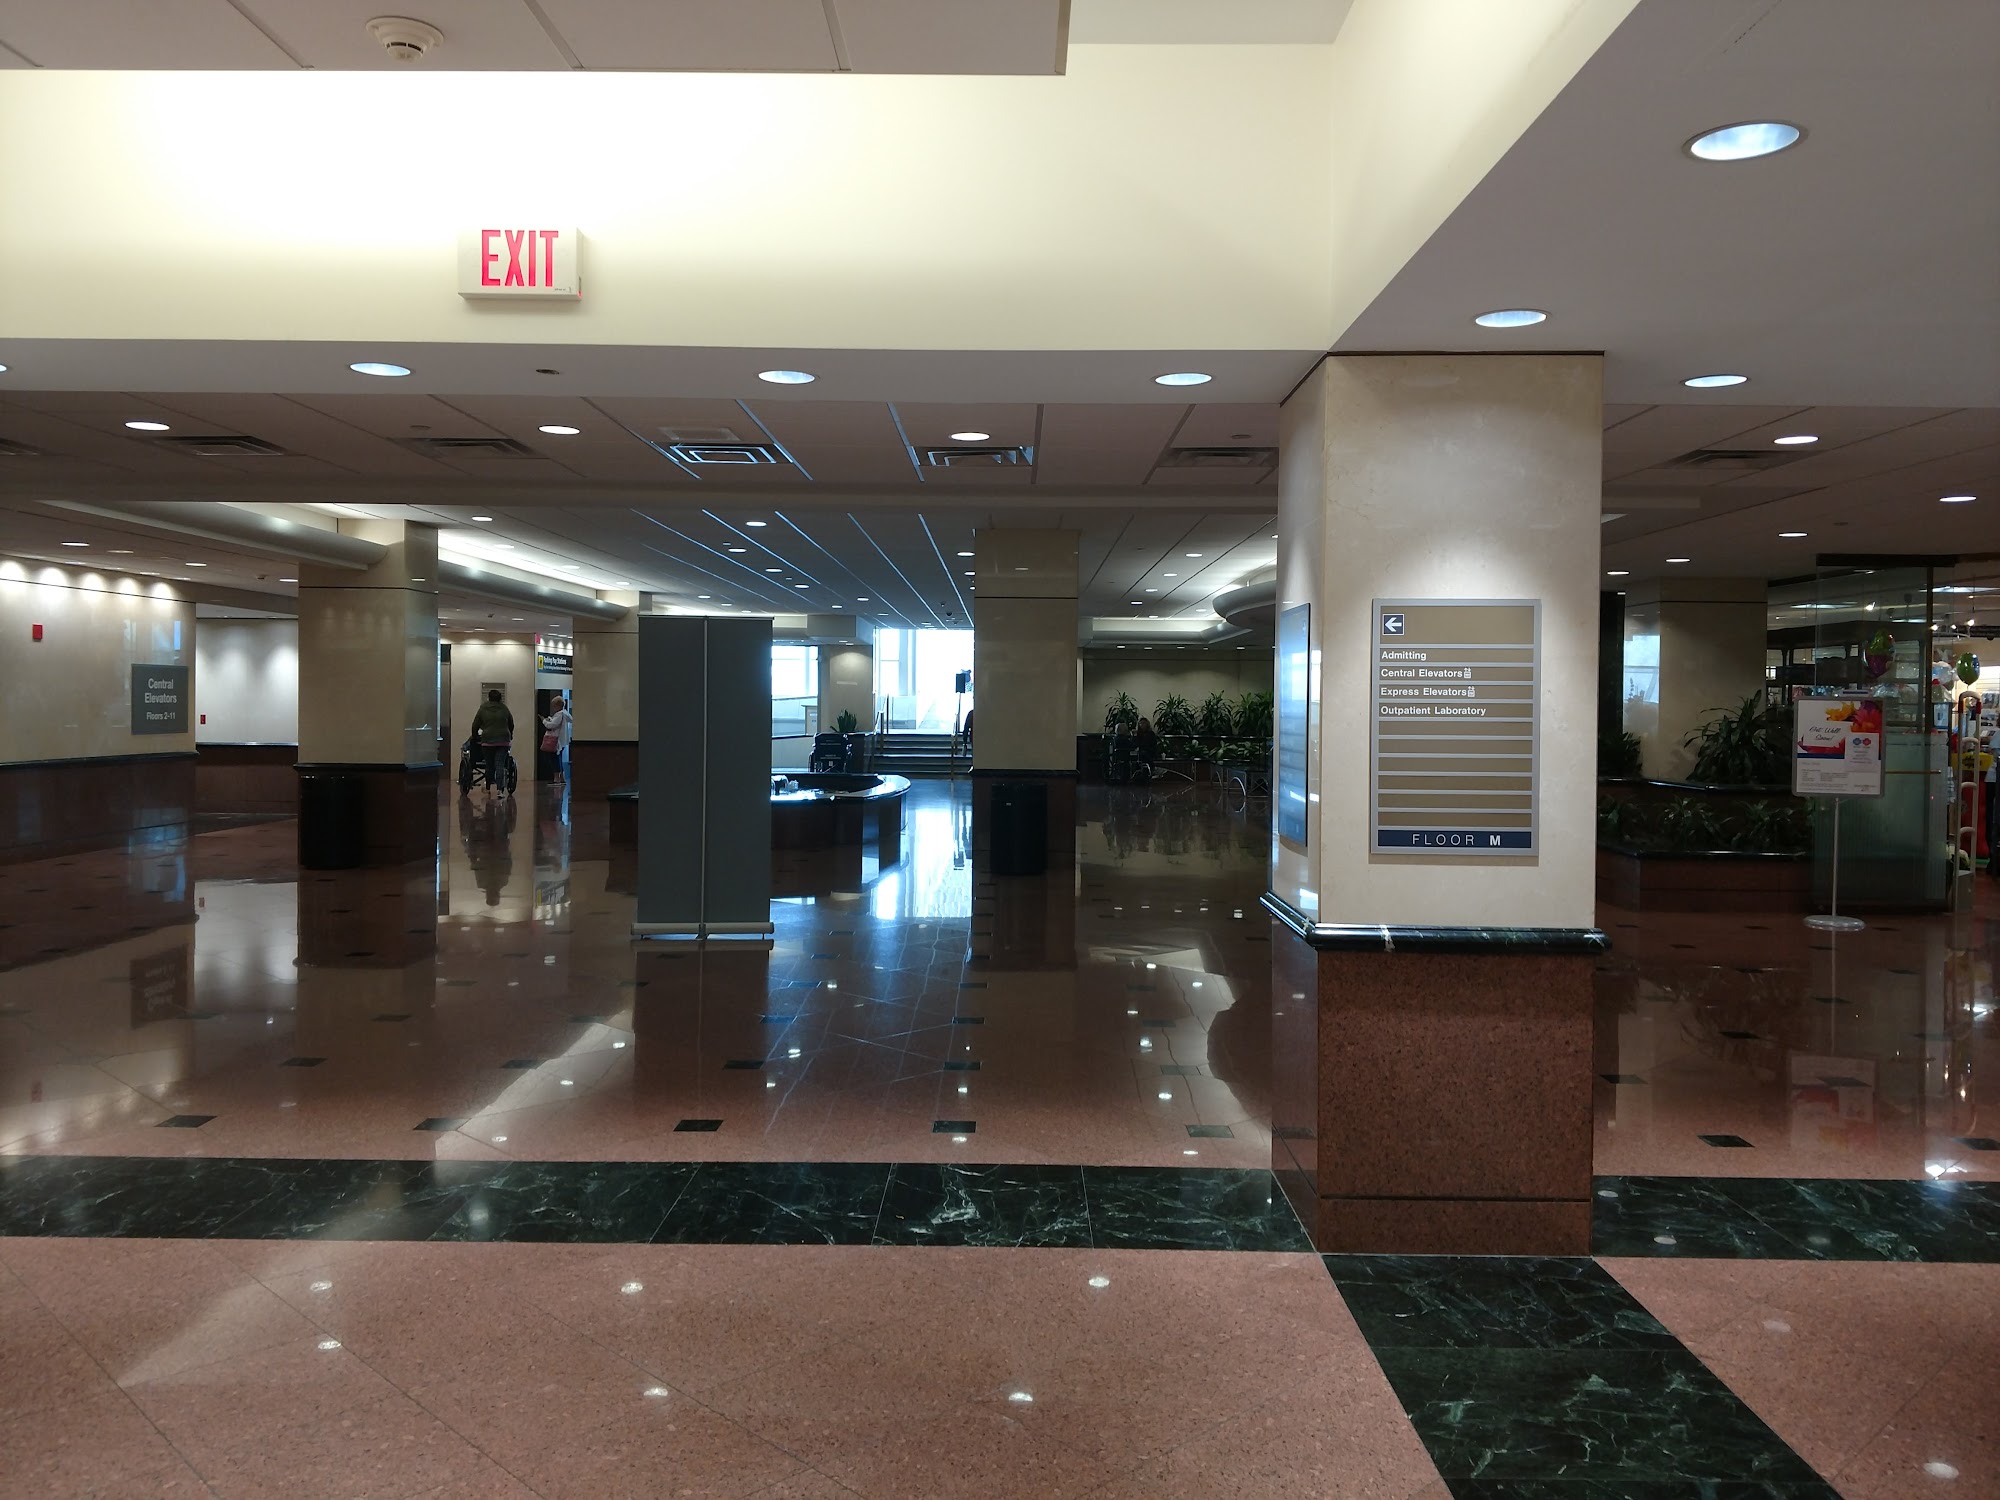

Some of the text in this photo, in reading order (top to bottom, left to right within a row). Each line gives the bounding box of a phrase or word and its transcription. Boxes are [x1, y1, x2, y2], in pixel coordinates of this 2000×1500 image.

[481, 229, 559, 287] EXIT
[1381, 651, 1427, 661] Admitting
[1380, 668, 1463, 678] Central Elevators
[148, 678, 173, 689] Central
[1380, 687, 1467, 697] Express Elevators
[144, 692, 177, 703] Elevators
[146, 711, 176, 720] Floors 2-11
[1380, 706, 1486, 716] Outpatient Laboratory
[1412, 833, 1501, 846] FLOOR M
